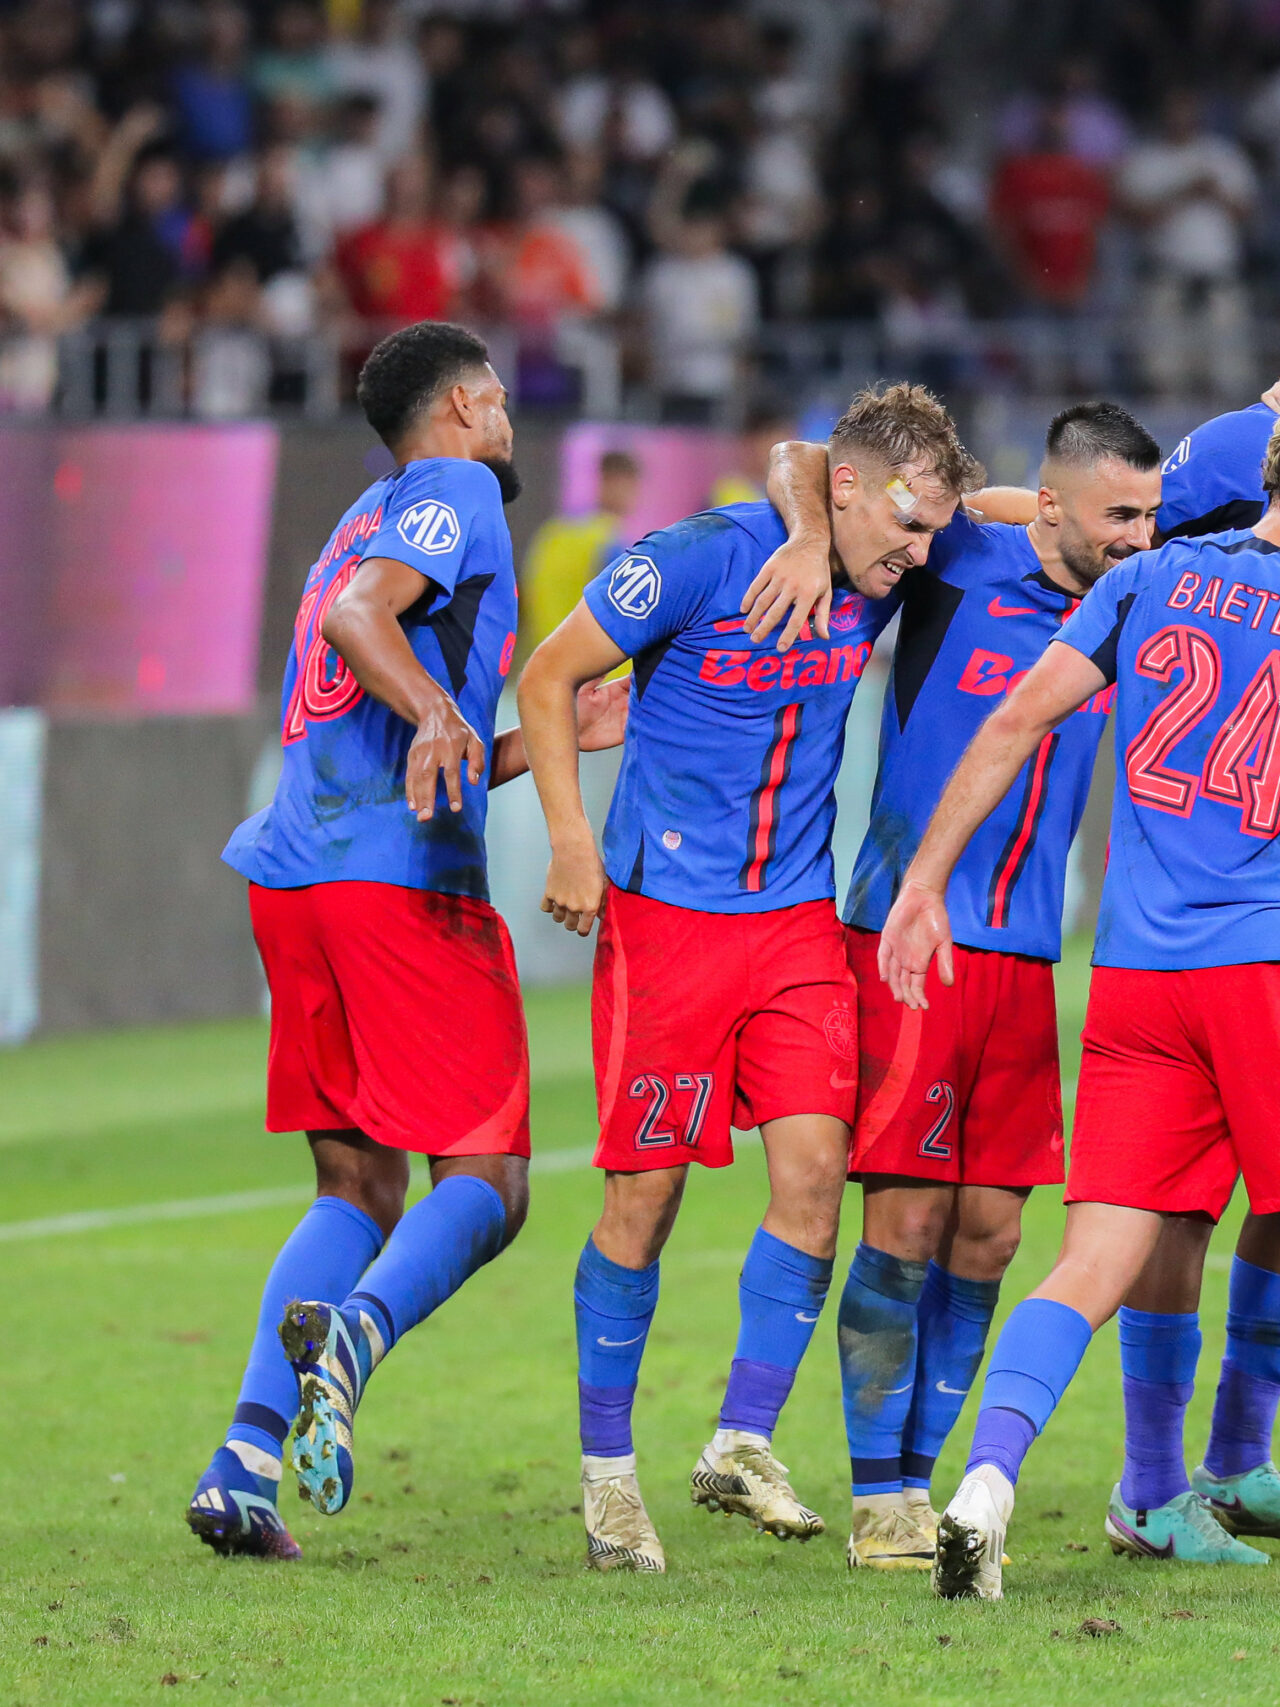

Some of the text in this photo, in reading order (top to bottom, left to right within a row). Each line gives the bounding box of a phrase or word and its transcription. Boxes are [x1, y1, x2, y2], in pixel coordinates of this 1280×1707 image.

[403, 503, 456, 550] MG
[614, 560, 656, 613] MG
[699, 641, 873, 692] Betano
[628, 1072, 714, 1150] 27
[917, 1079, 956, 1160] 2
